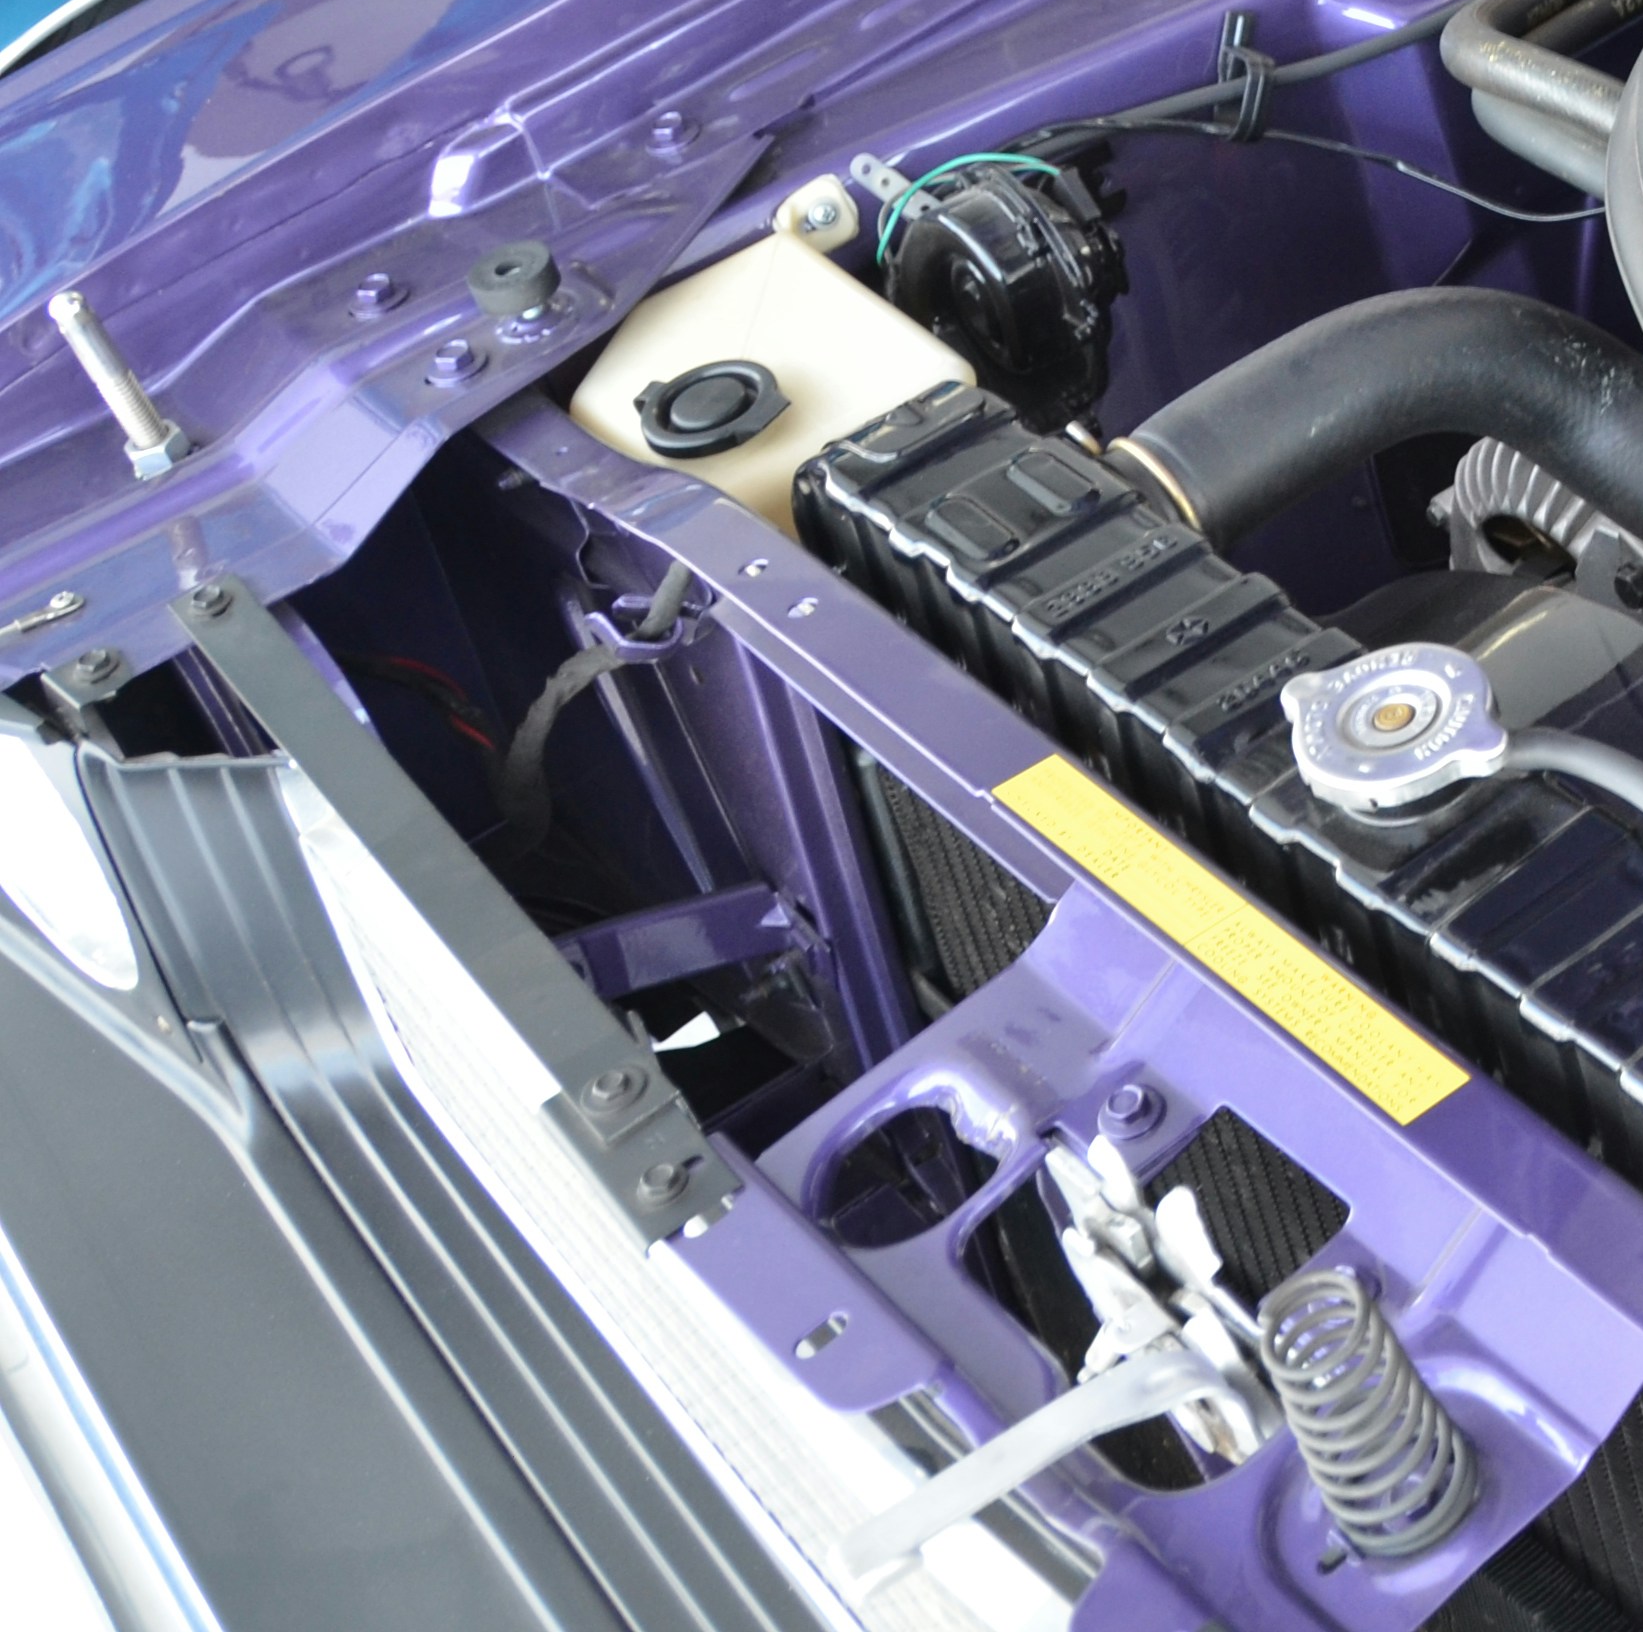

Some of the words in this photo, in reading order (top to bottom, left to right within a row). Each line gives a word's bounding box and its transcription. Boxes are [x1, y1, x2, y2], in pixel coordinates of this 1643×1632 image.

[1074, 844, 1122, 880] DEALER
[1100, 848, 1132, 872] DATE
[1194, 941, 1251, 986] COOLING
[1301, 1028, 1407, 1113] RECOMMENDATIONS
[1206, 934, 1249, 967] FREEZE
[1254, 972, 1279, 990] SEE
[1331, 1034, 1389, 1080] MANUAL
[1218, 926, 1264, 961] PROPER
[1265, 963, 1317, 1003] AMOUNT
[1315, 1003, 1337, 1019] OF
[1335, 1020, 1397, 1068] CHRYSLER
[1230, 919, 1280, 957] ALWAYS
[1279, 957, 1317, 986] MAKE
[1316, 986, 1351, 1013] SURE
[1348, 1013, 1414, 1064] COOLANT
[1317, 972, 1380, 1020] WARNING
